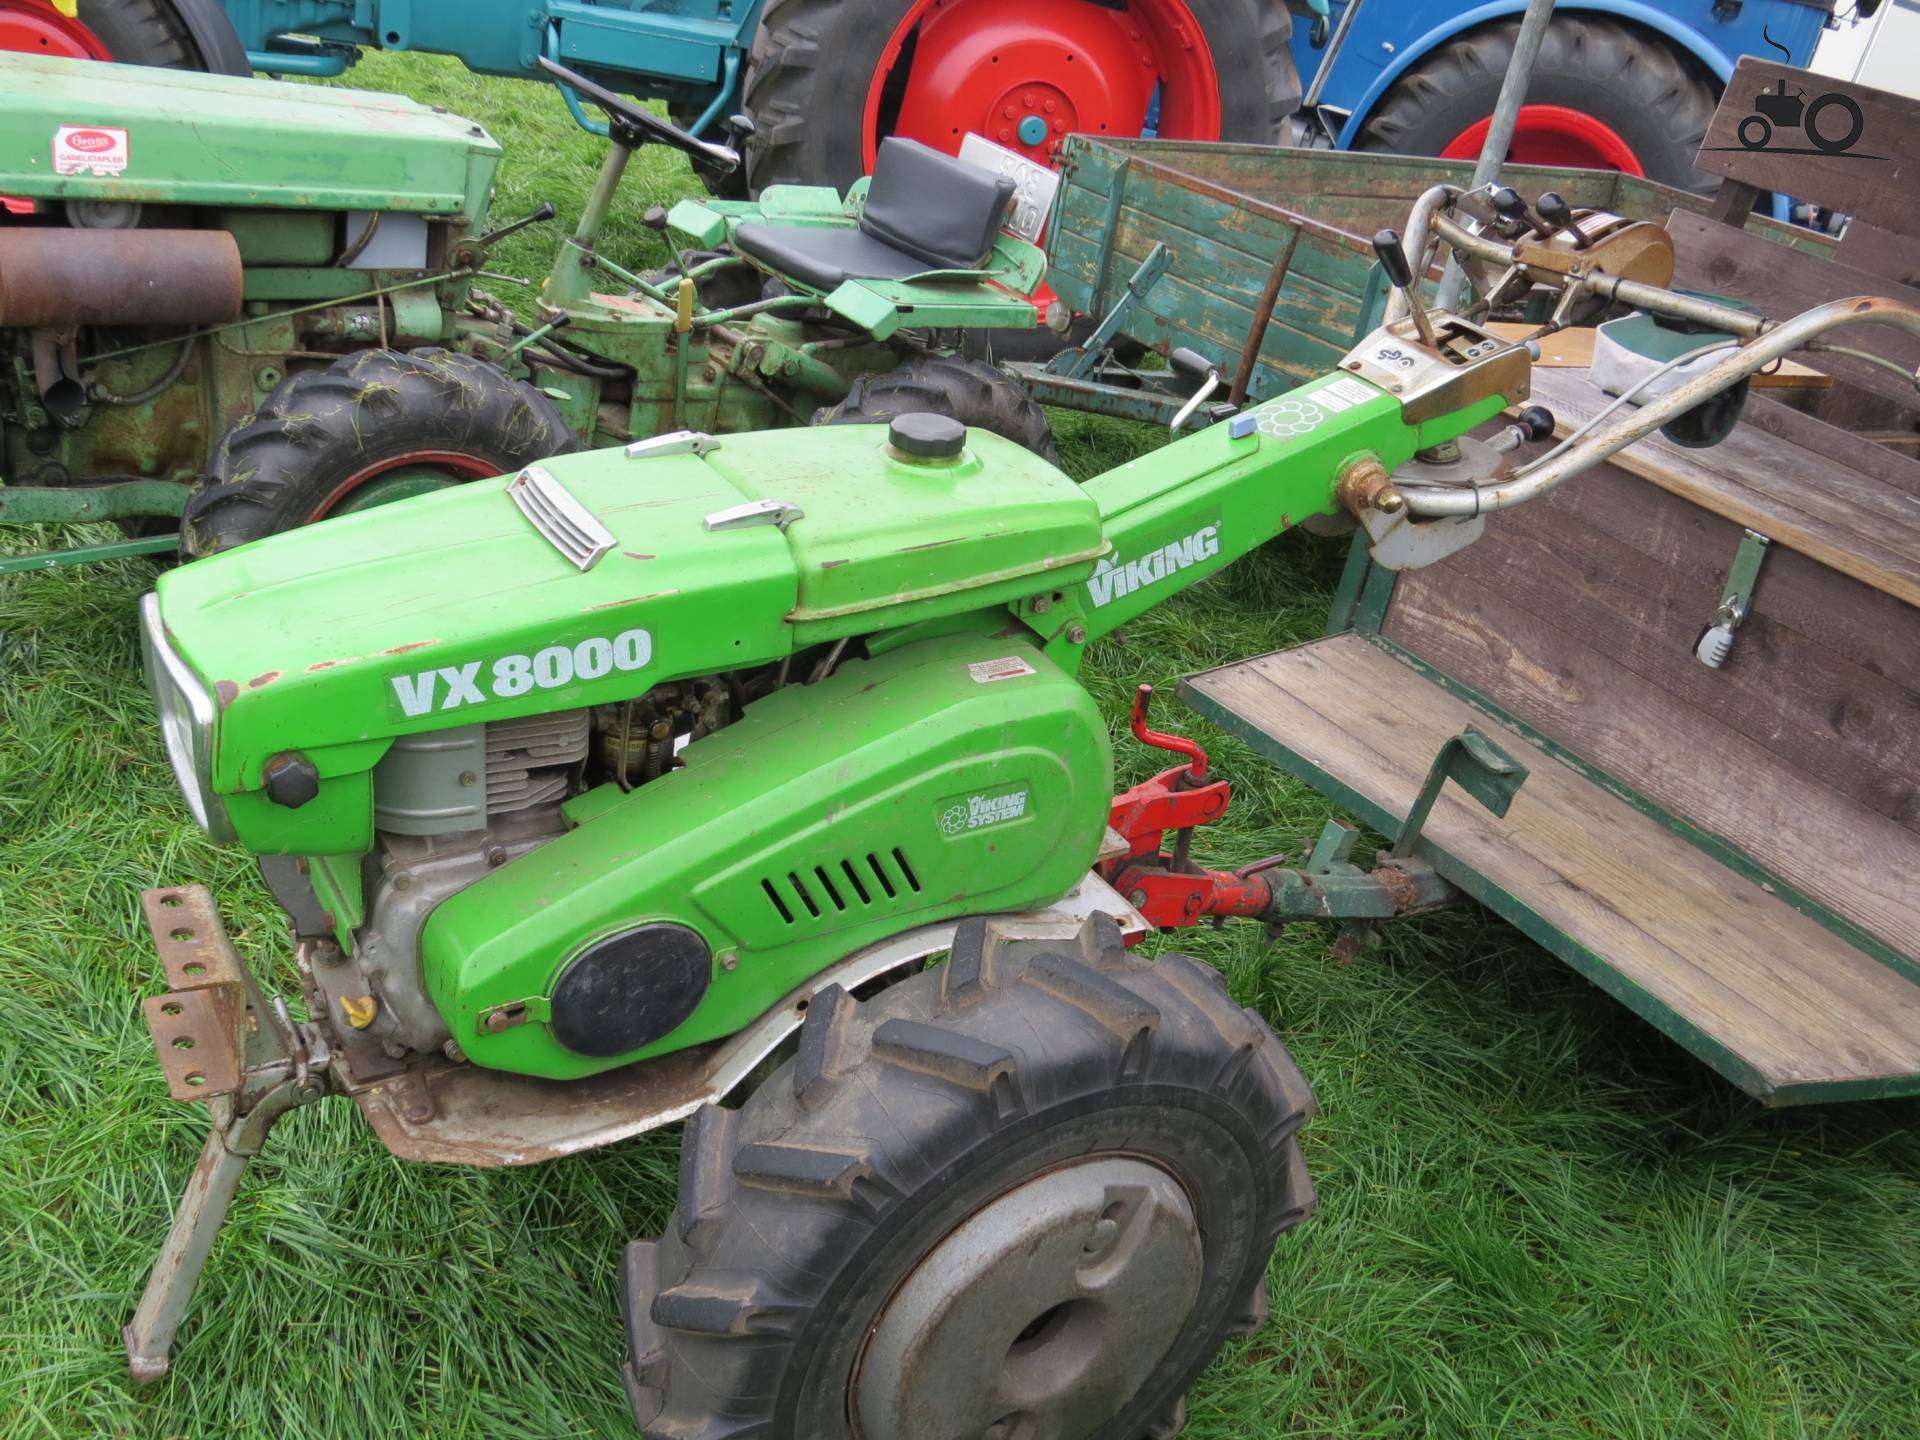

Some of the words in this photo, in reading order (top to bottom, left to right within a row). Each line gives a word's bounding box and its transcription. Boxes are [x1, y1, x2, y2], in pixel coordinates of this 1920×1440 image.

[391, 661, 487, 717] VX
[492, 629, 652, 697] 8000
[967, 804, 1025, 829] SYSTEM
[968, 791, 1026, 817] VIKING
